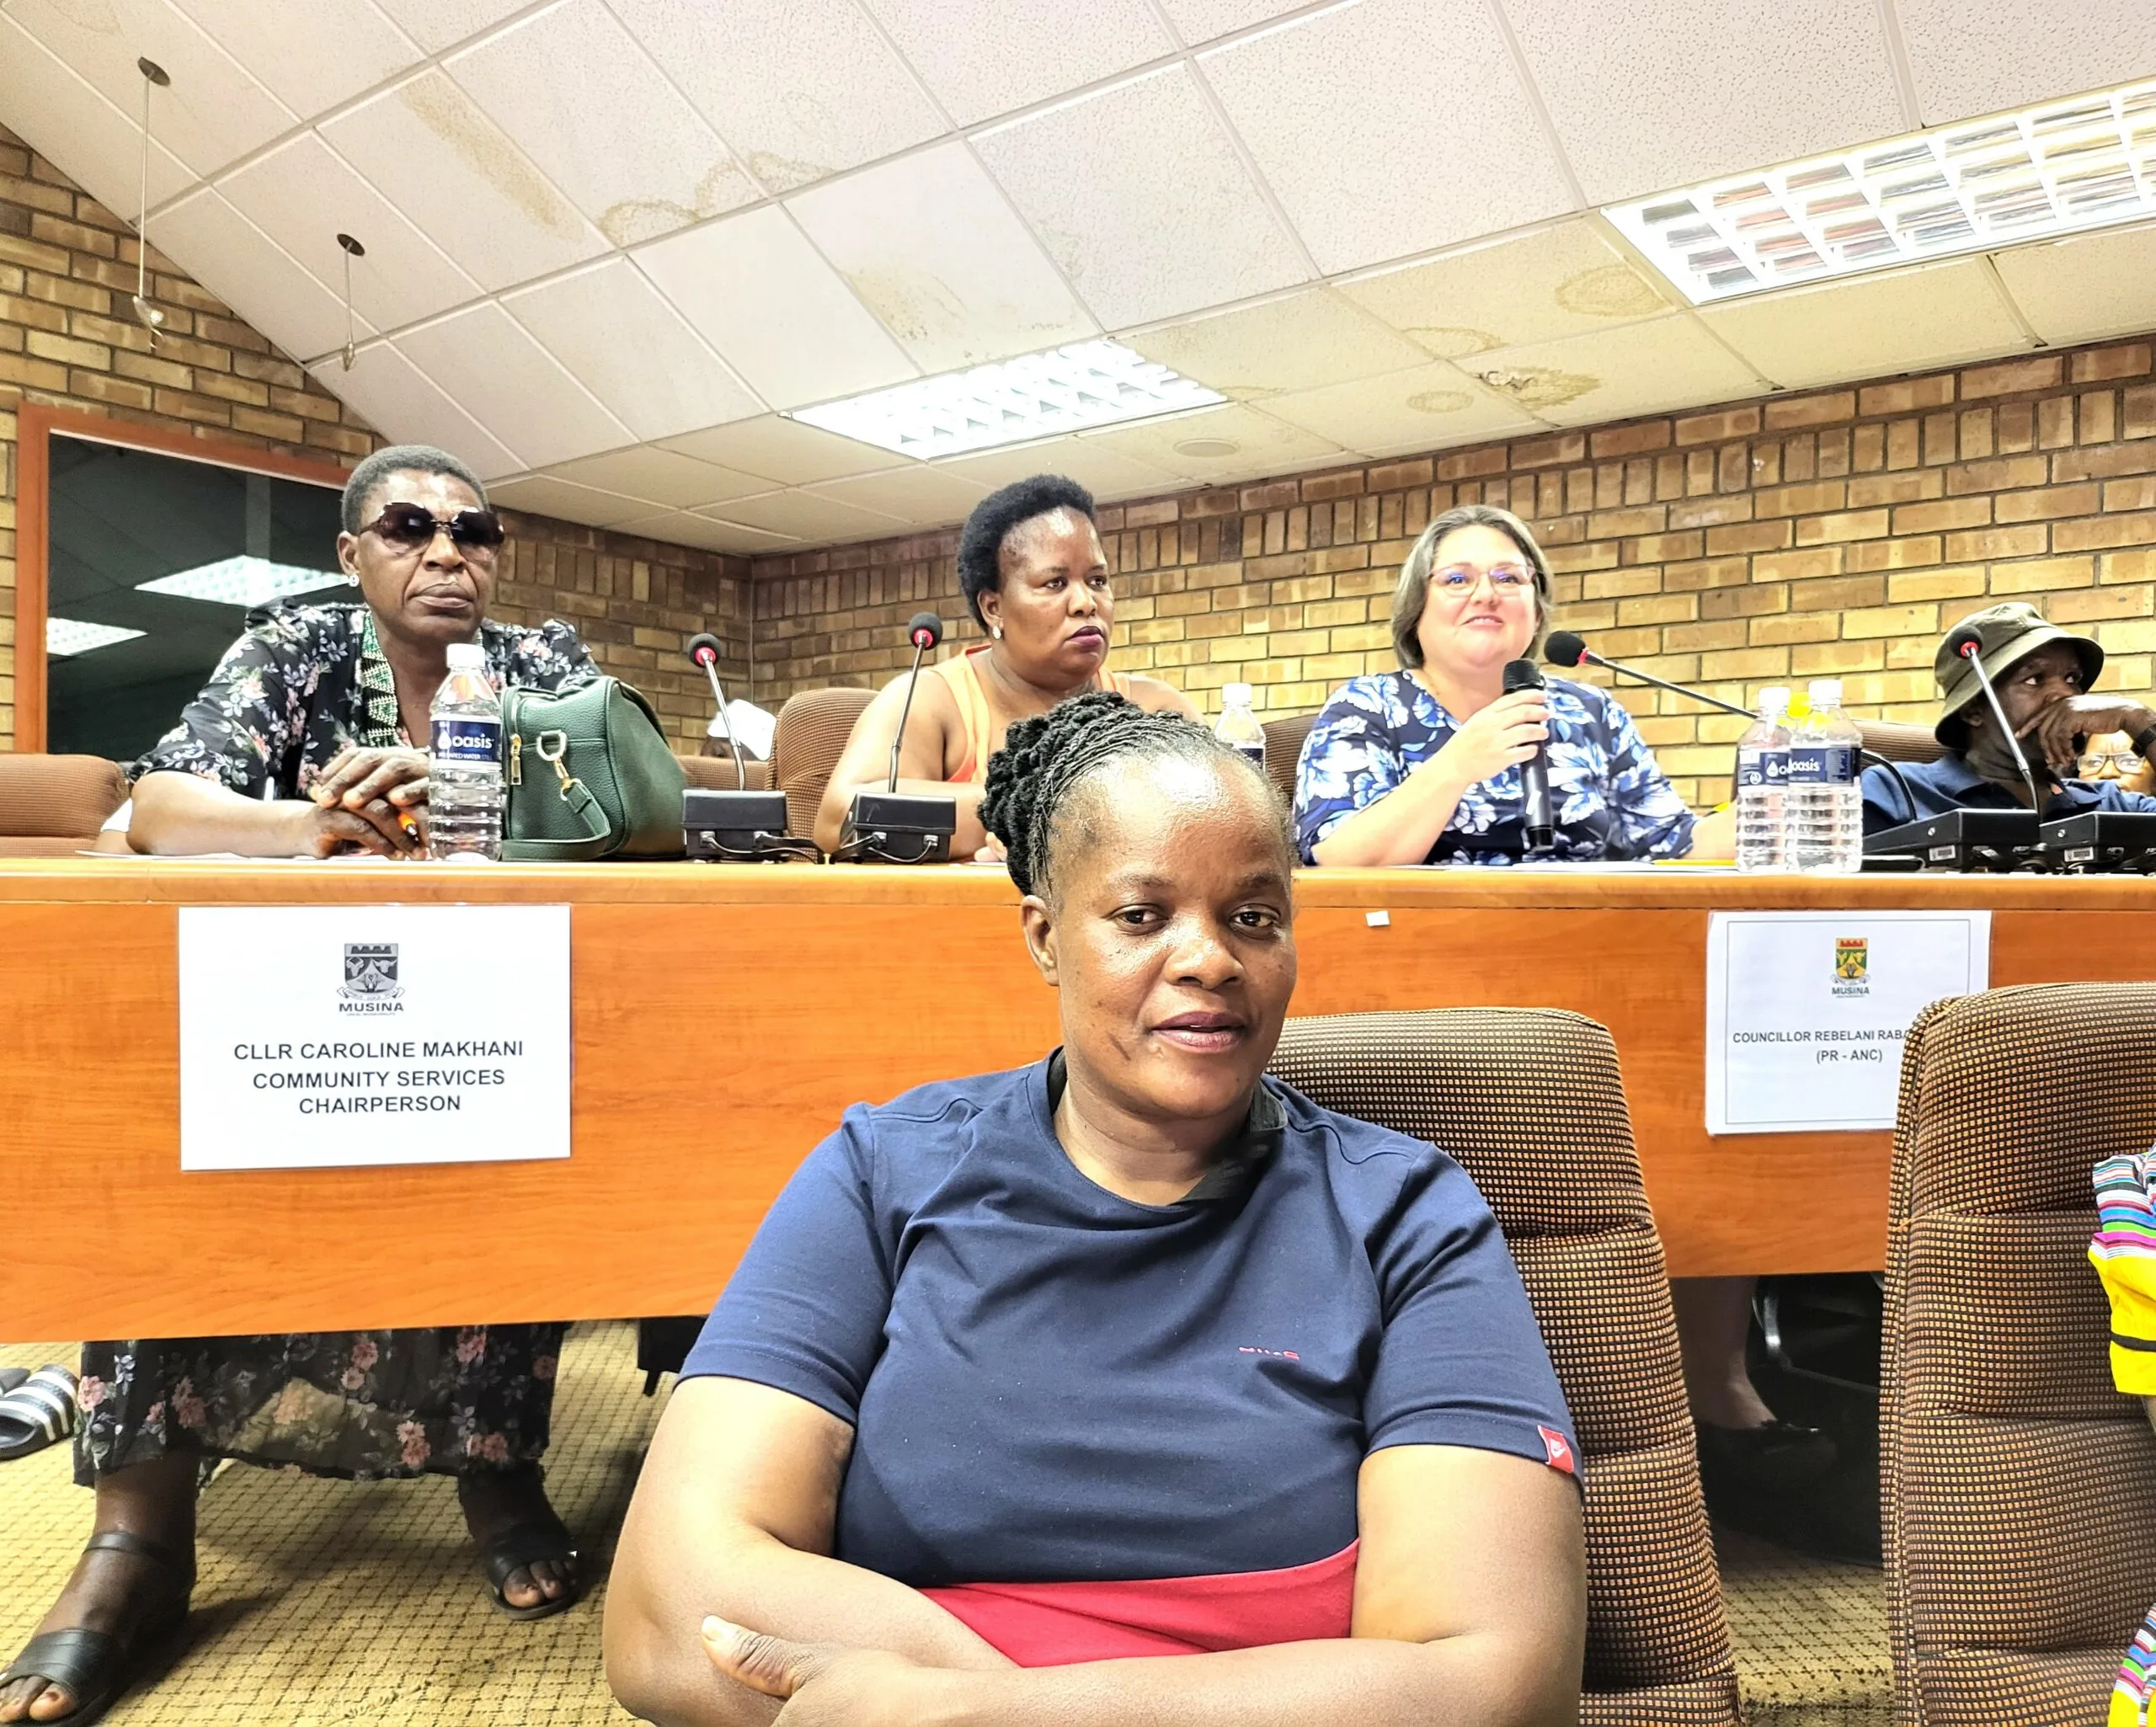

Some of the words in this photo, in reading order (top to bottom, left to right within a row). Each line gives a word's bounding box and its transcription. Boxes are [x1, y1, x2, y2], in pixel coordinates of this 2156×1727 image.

[452, 733, 493, 749] oasis
[1791, 758, 1820, 772] oasis
[339, 1002, 404, 1012] MUSINA
[1732, 1031, 1812, 1043] COUNCILLOR
[1815, 1030, 1875, 1042] REBELANI
[234, 1043, 293, 1061] CLLR
[300, 1042, 415, 1059] CAROLINE
[423, 1041, 523, 1058] MAKHANI
[1816, 1049, 1838, 1064] (PR
[1850, 1048, 1883, 1063] ANC)
[253, 1071, 390, 1090] COMMUNITY
[397, 1069, 504, 1086] SERVICES
[299, 1095, 461, 1114] CHAIRPERSON
